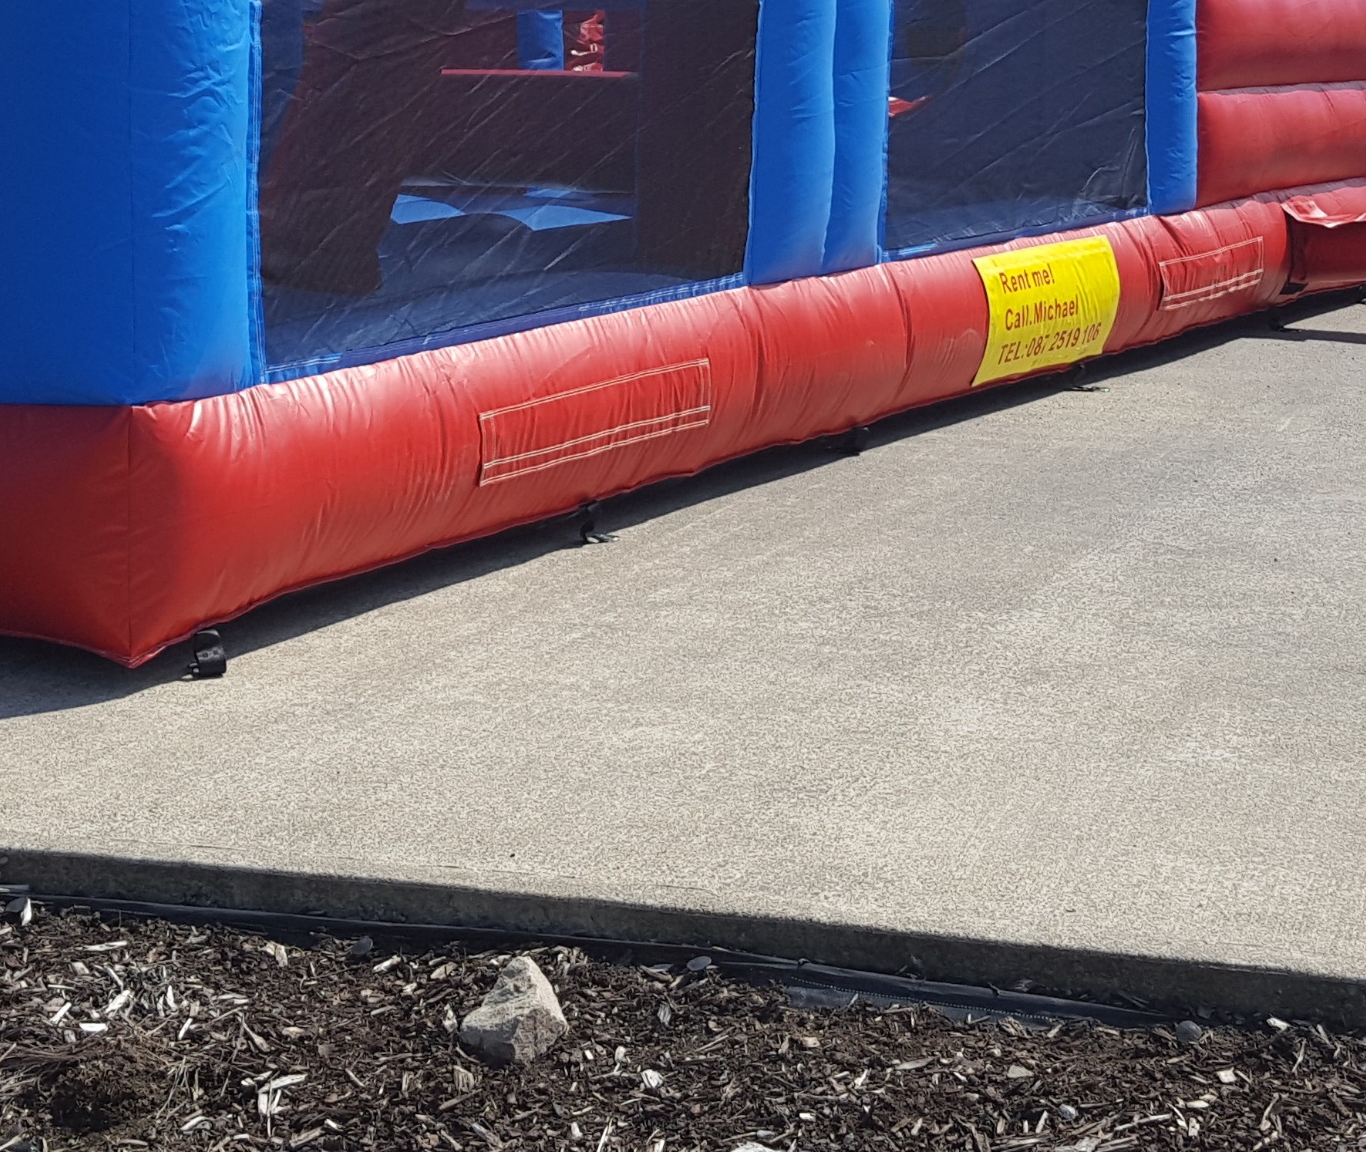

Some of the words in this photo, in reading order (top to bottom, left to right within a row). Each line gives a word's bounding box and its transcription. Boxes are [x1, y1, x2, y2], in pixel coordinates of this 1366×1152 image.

[998, 269, 1031, 294] Rent
[1031, 262, 1055, 287] me!
[1005, 294, 1079, 331] Call.Michael
[1048, 327, 1081, 352] 2519
[1081, 322, 1102, 345] 106
